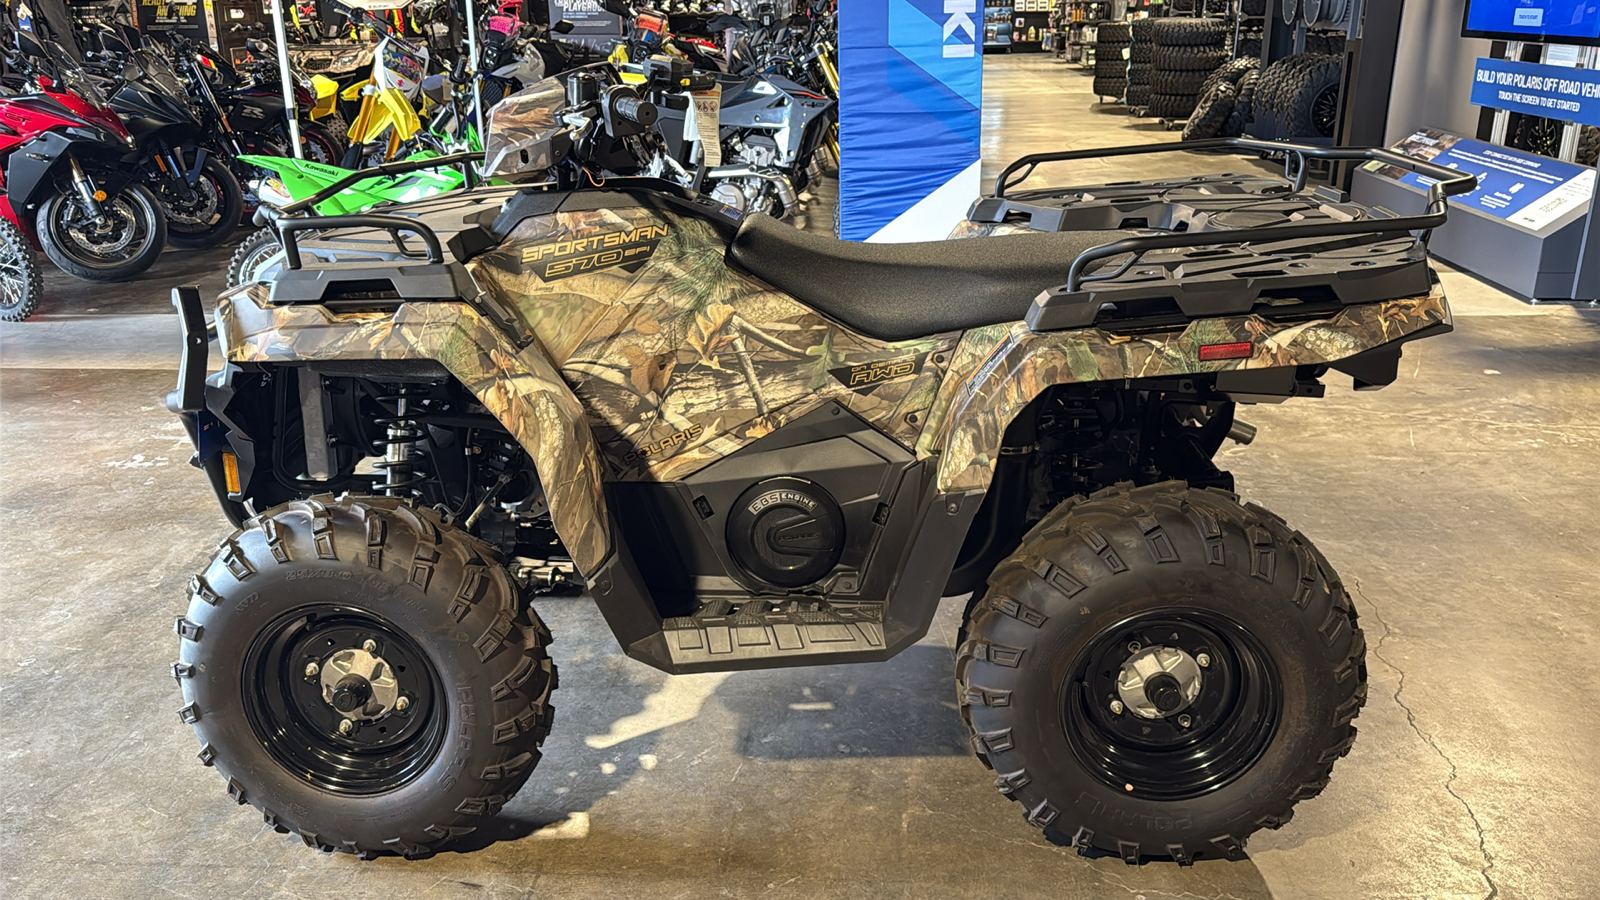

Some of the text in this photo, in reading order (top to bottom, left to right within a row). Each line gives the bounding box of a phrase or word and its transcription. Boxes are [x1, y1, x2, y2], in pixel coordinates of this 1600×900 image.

[1476, 69, 1600, 99] BUILD YOUR POLARIS OFF ROAD VEHI
[1498, 90, 1581, 112] TOUCH THE SCREEN TO GET STARTED
[304, 163, 339, 177] Kawasaki
[521, 223, 669, 264] SPORTSMAN
[545, 245, 650, 278] 570 EFI
[850, 361, 915, 385] AWD
[623, 422, 704, 466] POLARIS
[752, 493, 779, 512] EBS
[781, 492, 816, 508] ENGINE
